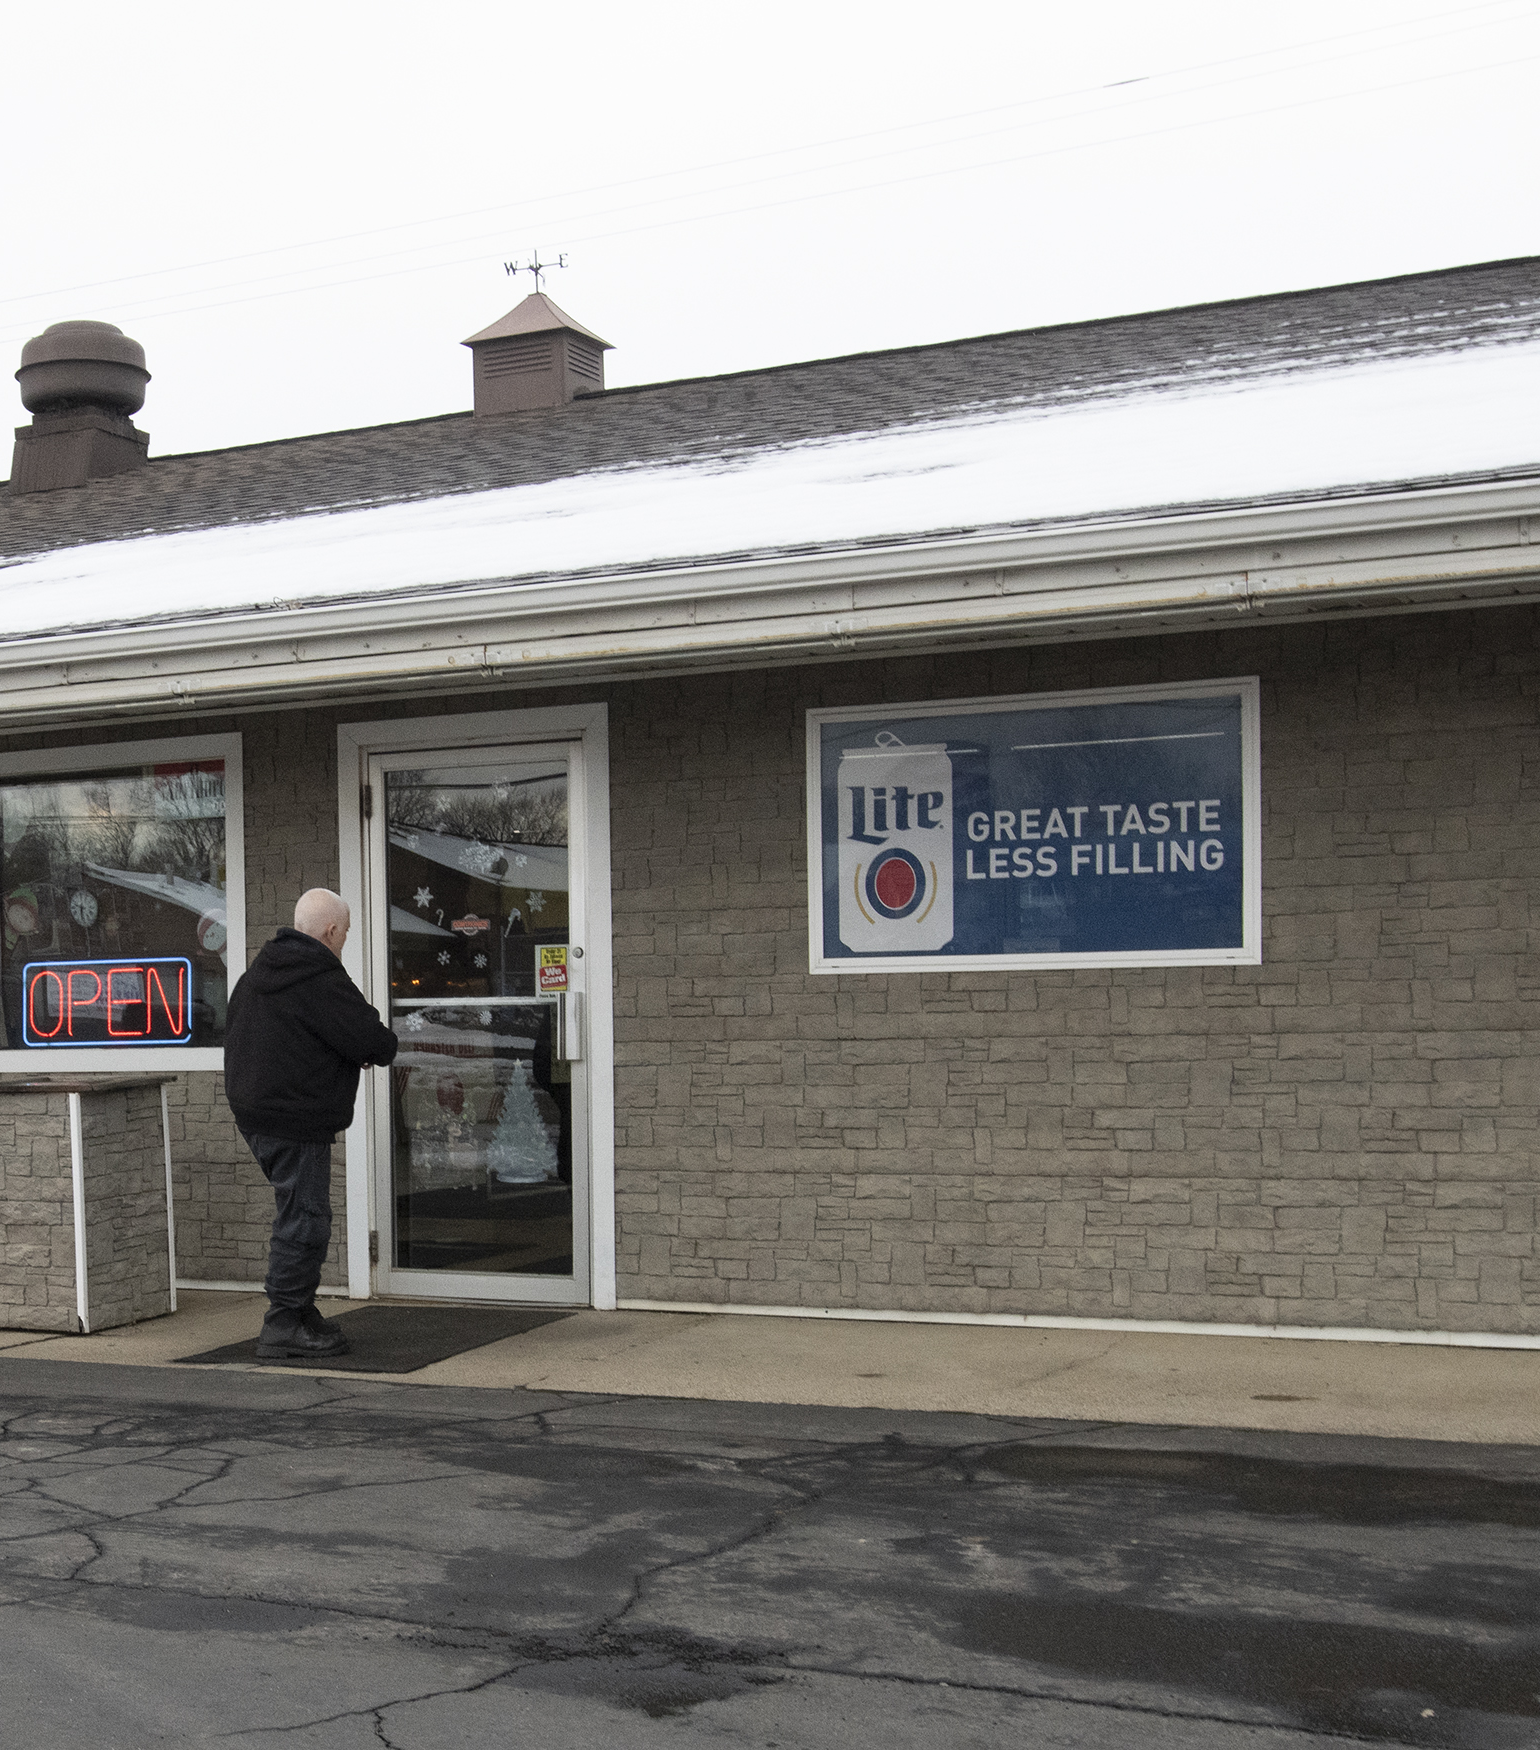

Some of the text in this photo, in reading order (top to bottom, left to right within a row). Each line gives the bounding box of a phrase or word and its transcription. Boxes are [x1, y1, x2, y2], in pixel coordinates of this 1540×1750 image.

[846, 786, 944, 845] Lite
[967, 799, 1221, 842] GREAT TASTE
[966, 838, 1224, 880] LESS FILLING
[541, 973, 566, 985] Card
[544, 966, 562, 976] We
[29, 967, 184, 1037] OPEN
